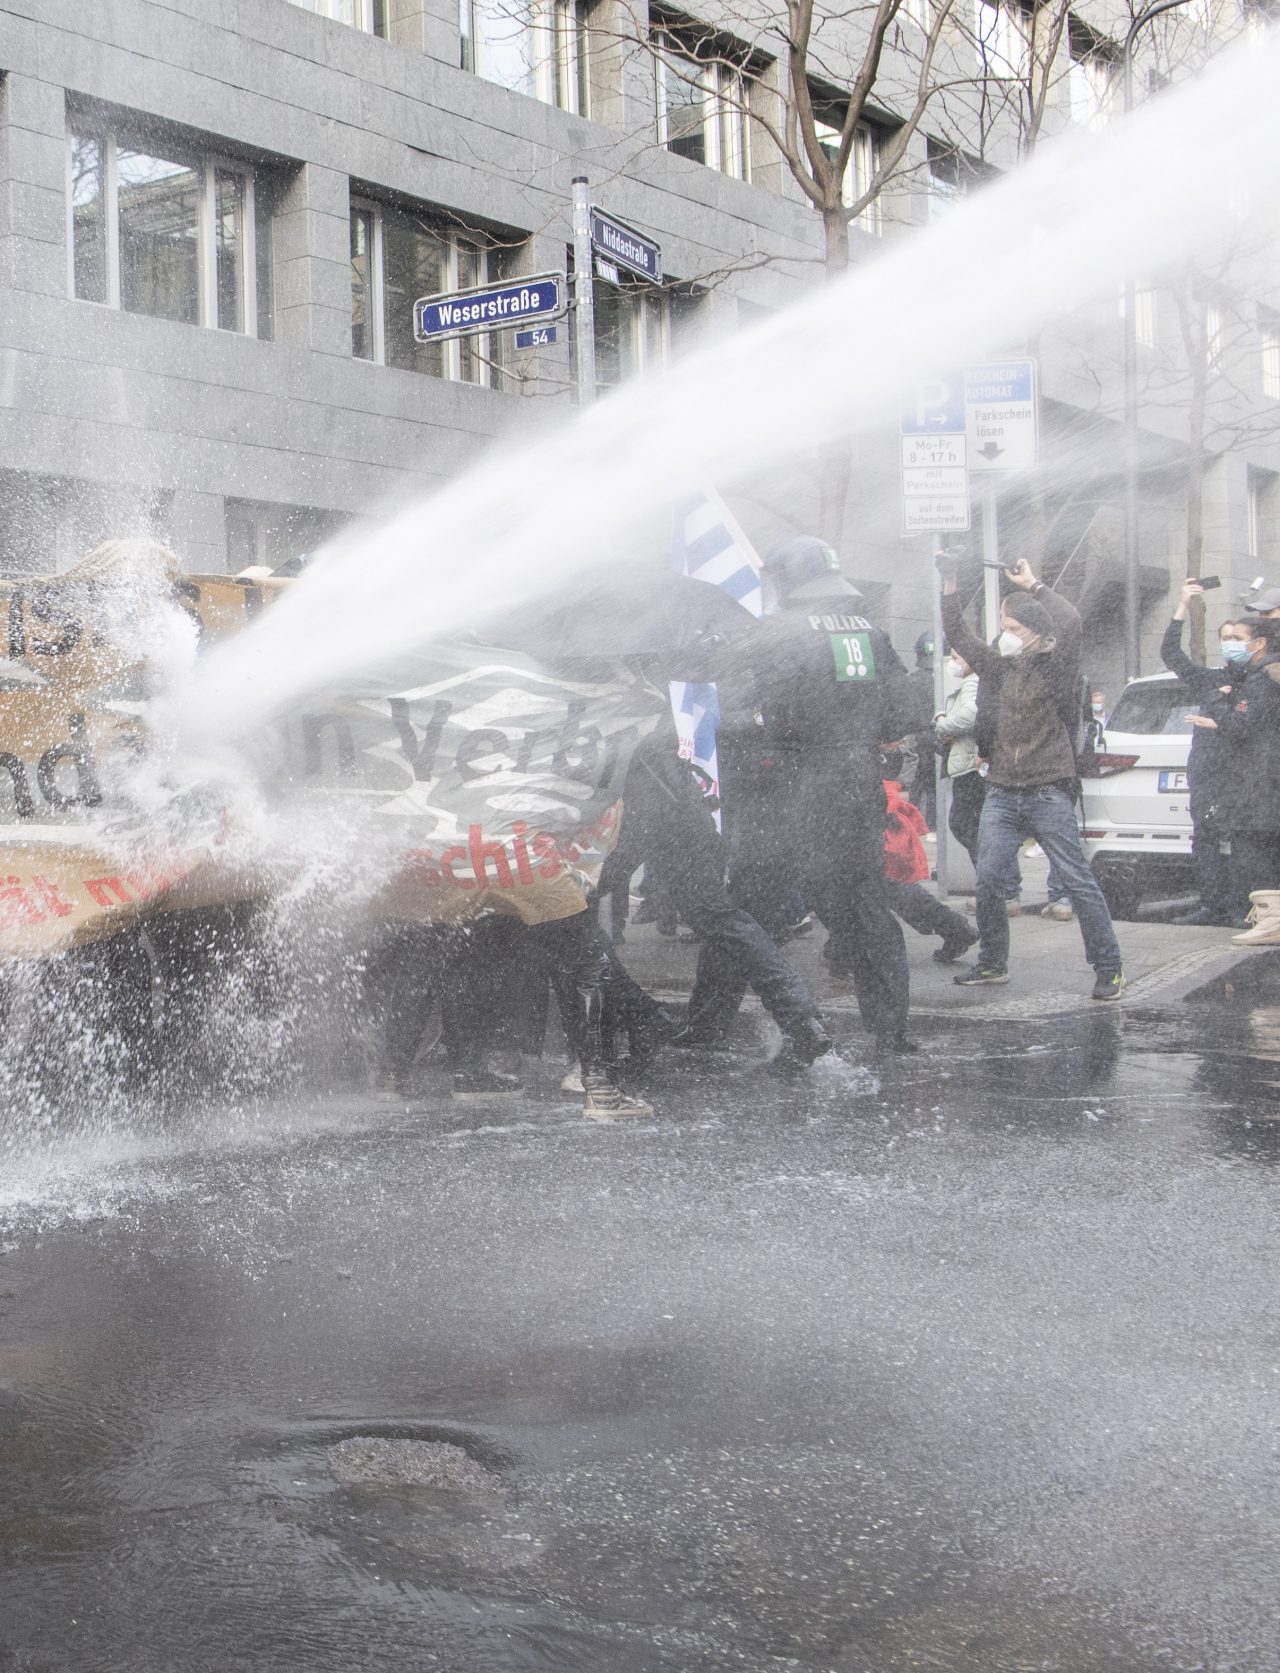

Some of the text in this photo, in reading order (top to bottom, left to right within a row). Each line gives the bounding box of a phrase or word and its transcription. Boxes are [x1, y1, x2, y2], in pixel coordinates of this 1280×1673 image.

[602, 223, 649, 268] Niddastraße
[438, 289, 540, 326] Weserstraße
[532, 331, 548, 346] 54
[916, 379, 951, 427] P
[975, 408, 1032, 422] Parkschein
[976, 425, 1005, 437] lösen
[915, 439, 952, 450] Mo-Fr
[910, 452, 917, 463] 8
[930, 451, 945, 462] 17
[948, 451, 957, 462] h
[907, 480, 963, 489] Parkschein
[807, 613, 873, 631] POLIZEI
[842, 638, 864, 663] 18
